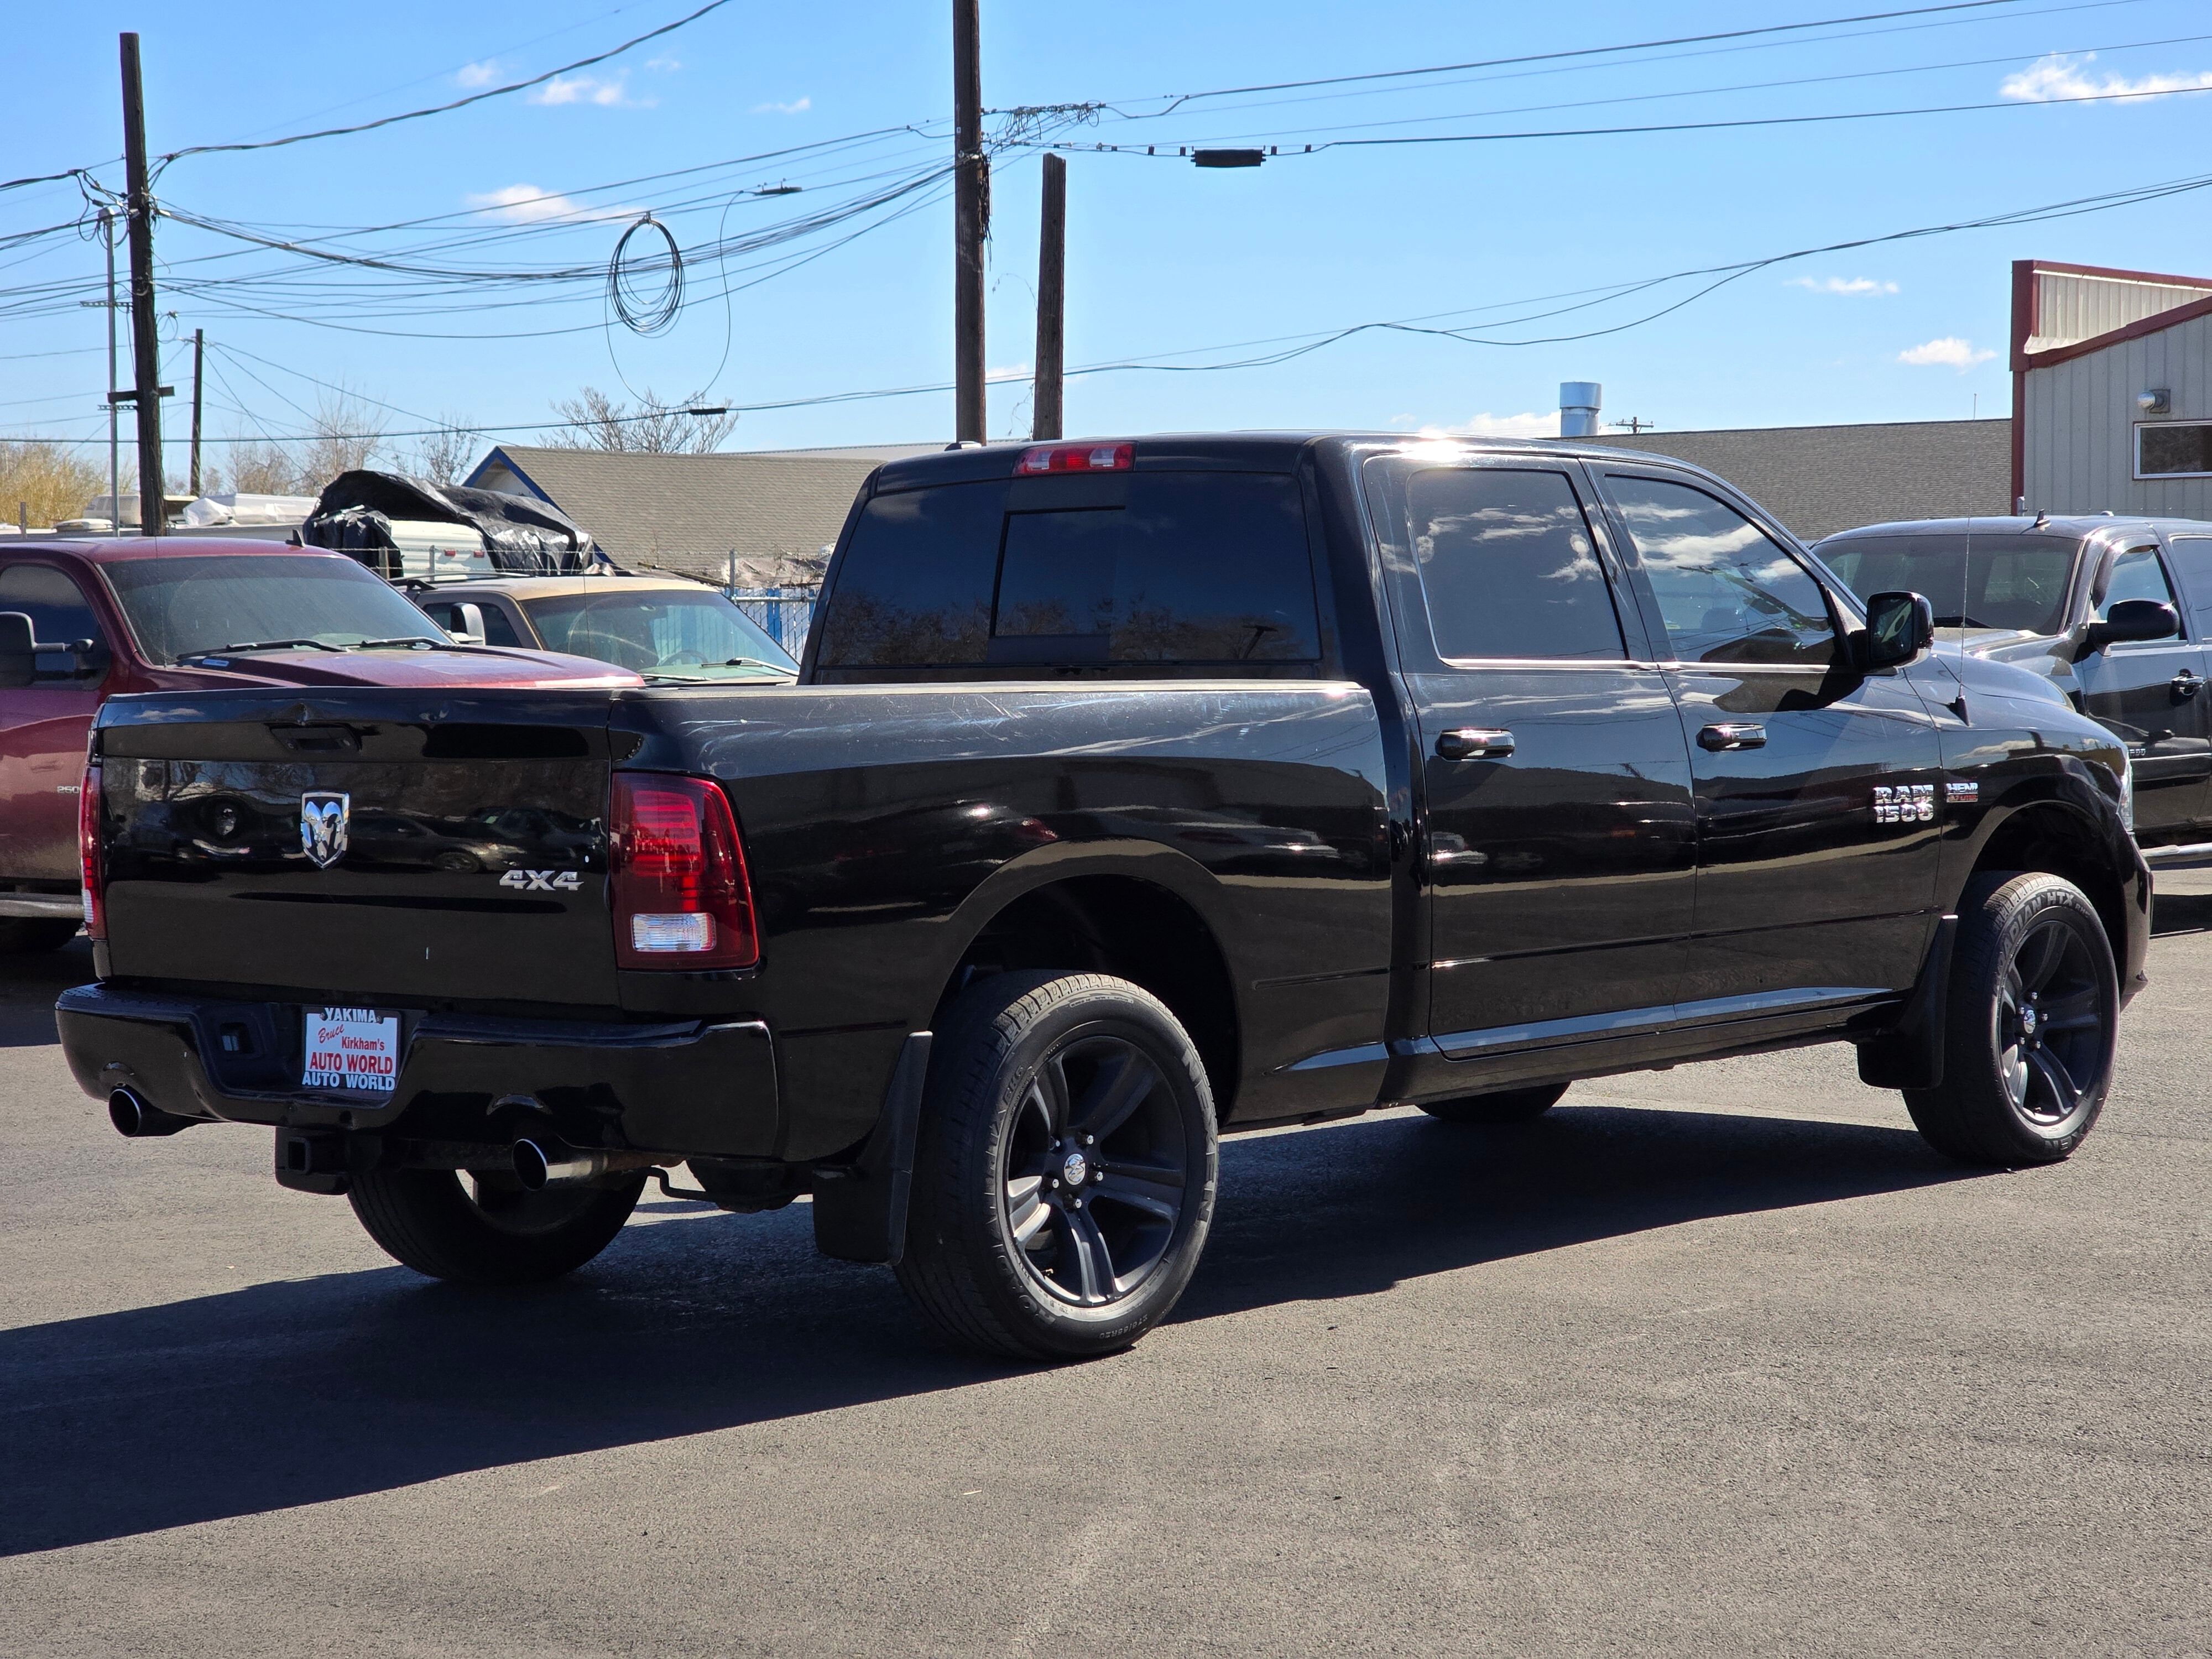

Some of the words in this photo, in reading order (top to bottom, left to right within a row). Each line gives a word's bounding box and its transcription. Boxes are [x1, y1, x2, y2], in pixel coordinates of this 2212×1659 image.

[1873, 784, 1934, 804] RAM
[1874, 803, 1934, 823] 1500
[2047, 891, 2074, 906] HTX
[324, 1007, 377, 1023] YAKIMA
[318, 1024, 345, 1044] Bruce
[341, 1036, 385, 1051] Kirkham's
[310, 1052, 343, 1071] AUTO
[346, 1054, 393, 1074] WORLD
[302, 1072, 340, 1087] AUTO
[346, 1074, 395, 1091] WORLD
[1181, 1048, 1216, 1223] NEXEN
